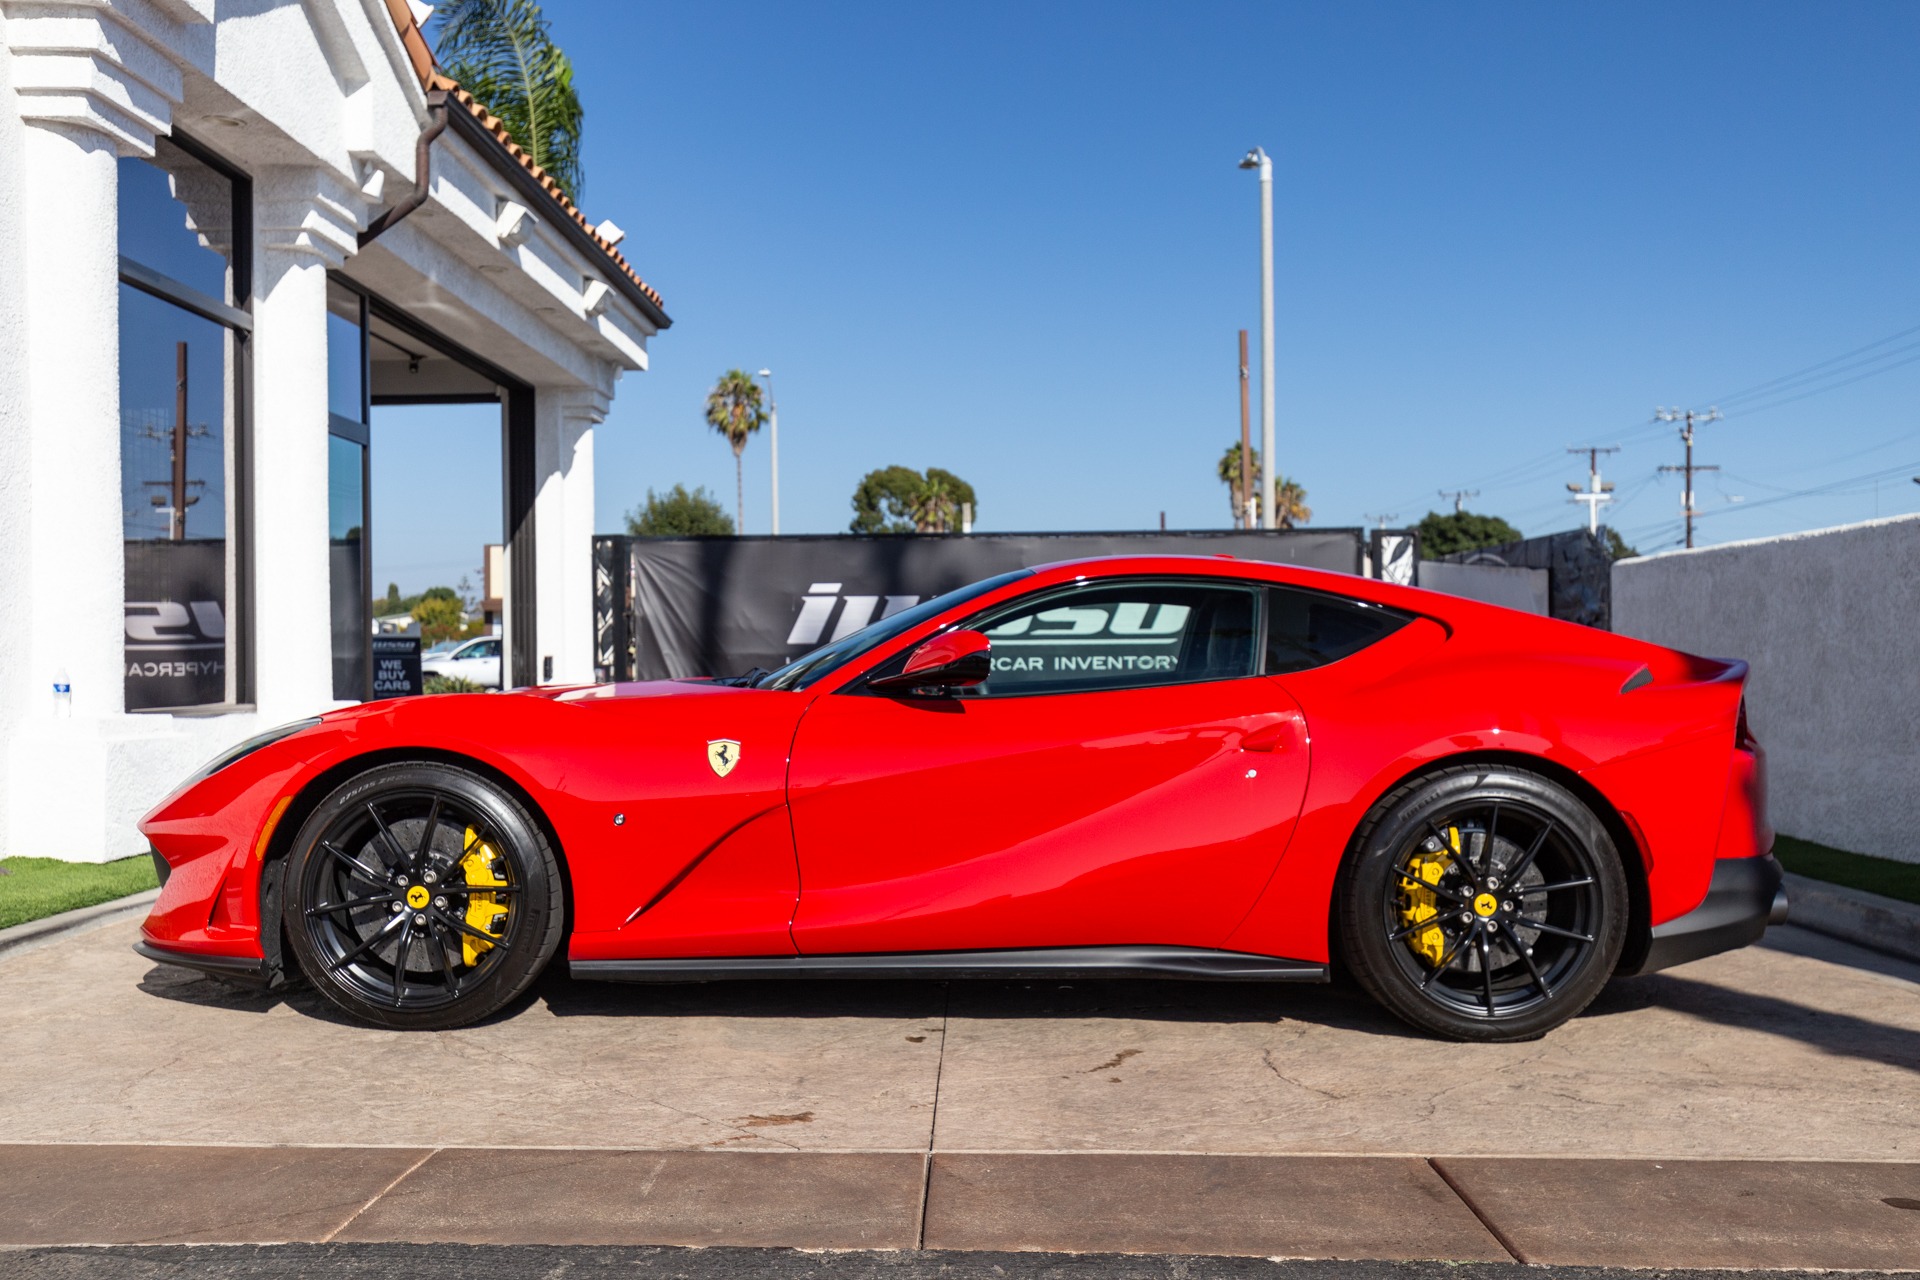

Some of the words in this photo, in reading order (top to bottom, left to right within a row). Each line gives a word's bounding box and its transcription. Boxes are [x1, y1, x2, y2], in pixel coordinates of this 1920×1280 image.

[380, 659, 402, 670] WE
[378, 670, 406, 680] BUY
[374, 680, 411, 691] CARS
